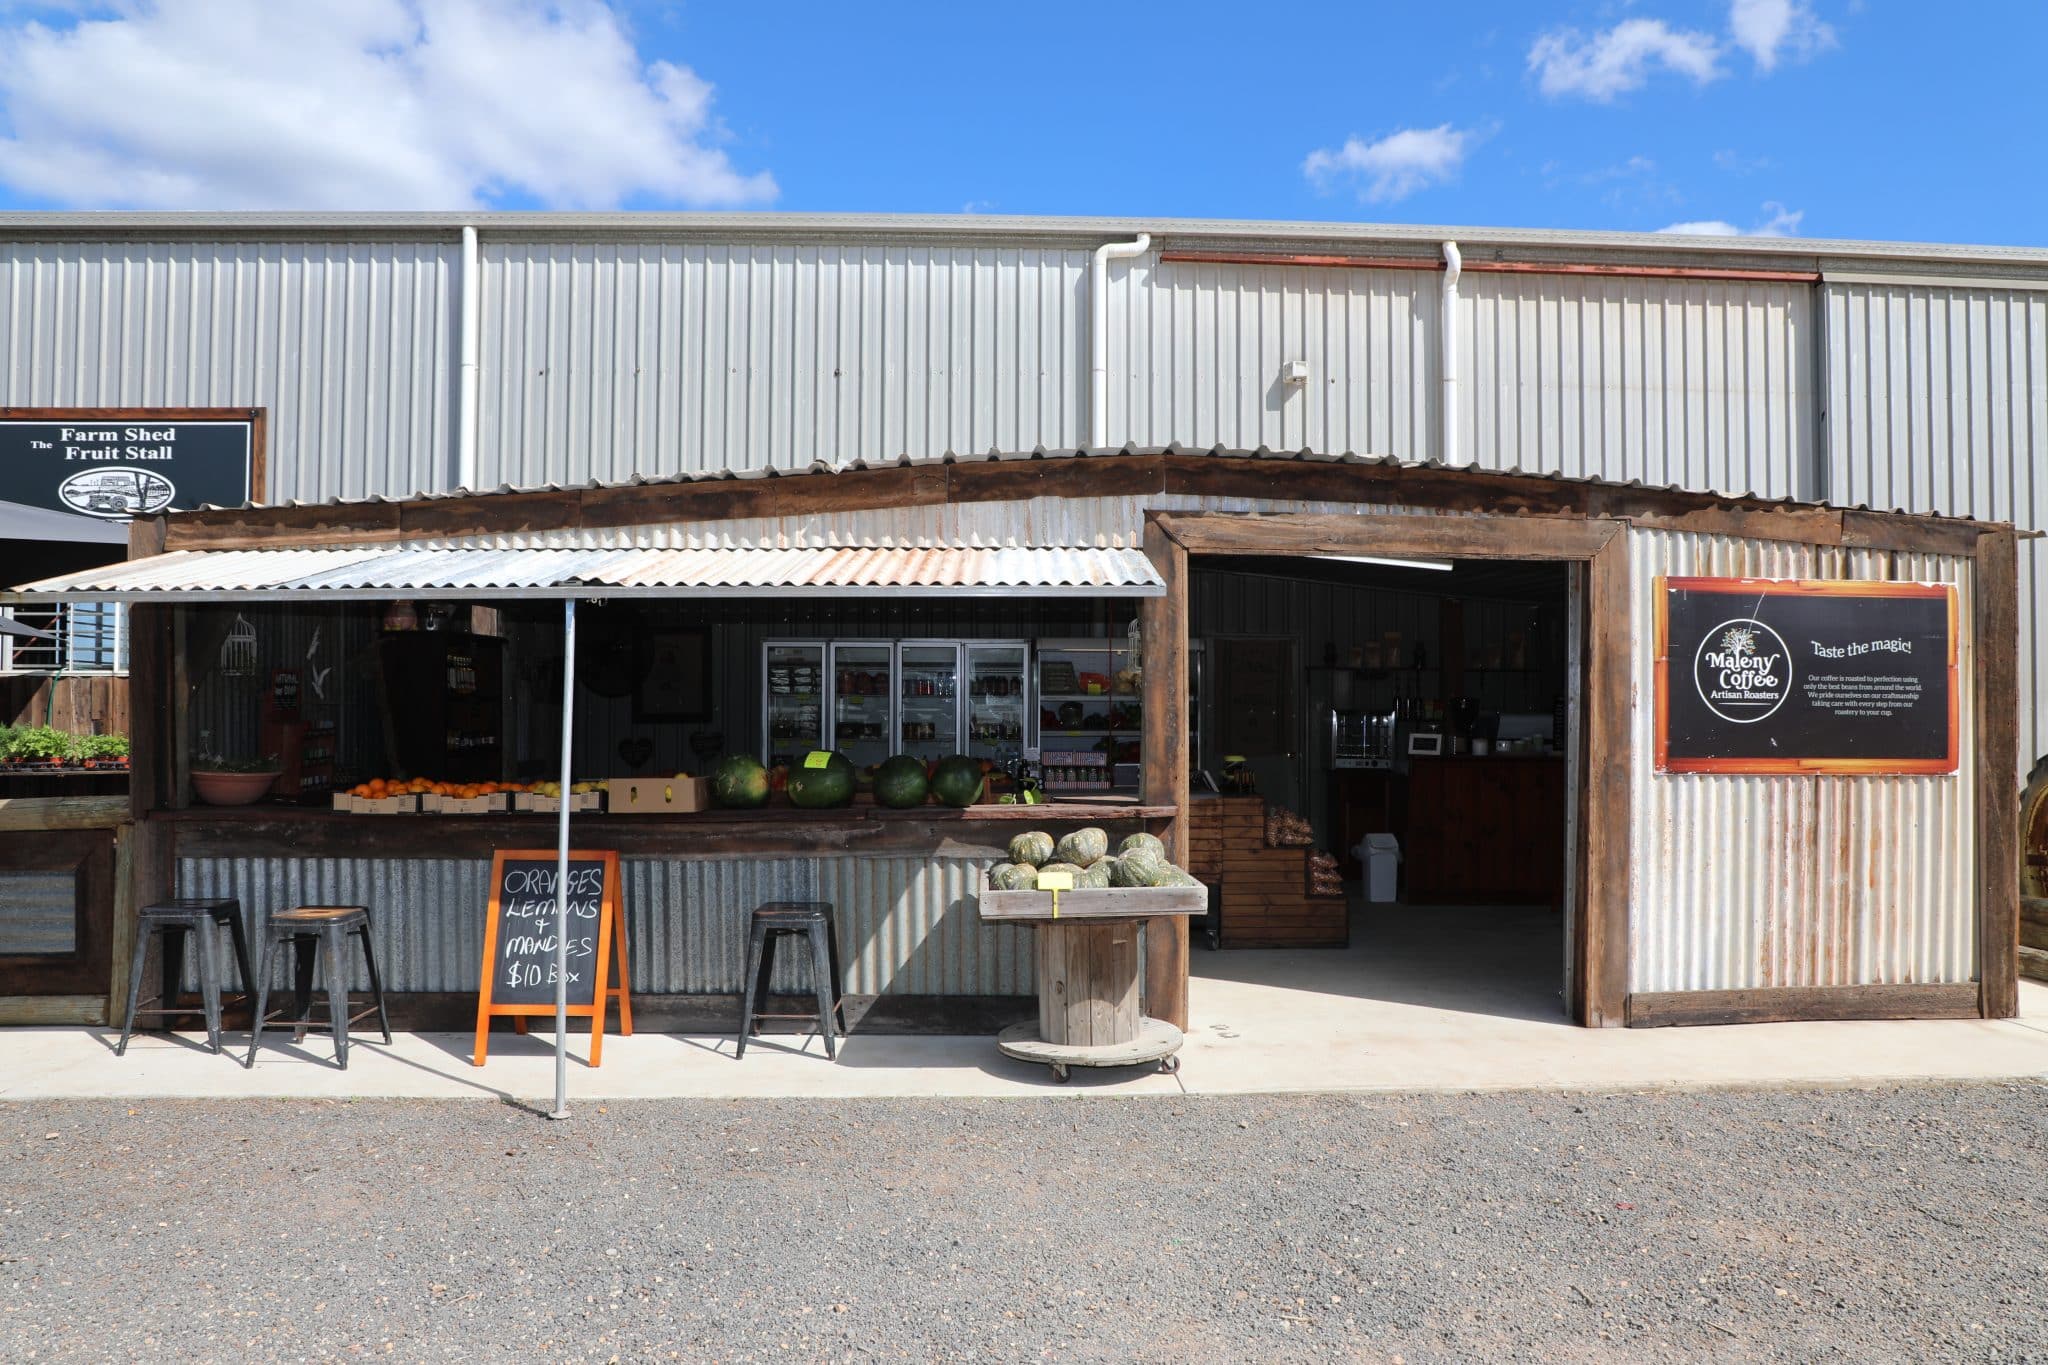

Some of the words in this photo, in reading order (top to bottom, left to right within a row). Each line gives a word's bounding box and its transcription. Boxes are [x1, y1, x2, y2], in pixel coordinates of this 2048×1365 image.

[60, 428, 119, 442] Farm
[124, 428, 176, 442] Shed
[30, 440, 53, 449] The
[65, 446, 120, 460] Fruit
[125, 446, 172, 460] Stall
[1811, 640, 1845, 658] Taste
[1847, 642, 1869, 656] the
[1871, 637, 1912, 654] magic!
[1705, 652, 1780, 676] Maleny
[1720, 669, 1778, 690] Coffee
[1820, 674, 1839, 682] coffee
[1874, 675, 1902, 683] perfection
[1903, 676, 1919, 684] using
[1710, 690, 1742, 699] Artisan
[1744, 690, 1779, 699] Roasters
[1819, 691, 1834, 699] pride
[1811, 700, 1830, 708] taking
[1834, 709, 1858, 717] roastery
[506, 898, 598, 918] LEMNS
[506, 935, 592, 959] MANDES
[506, 960, 542, 988] $10
